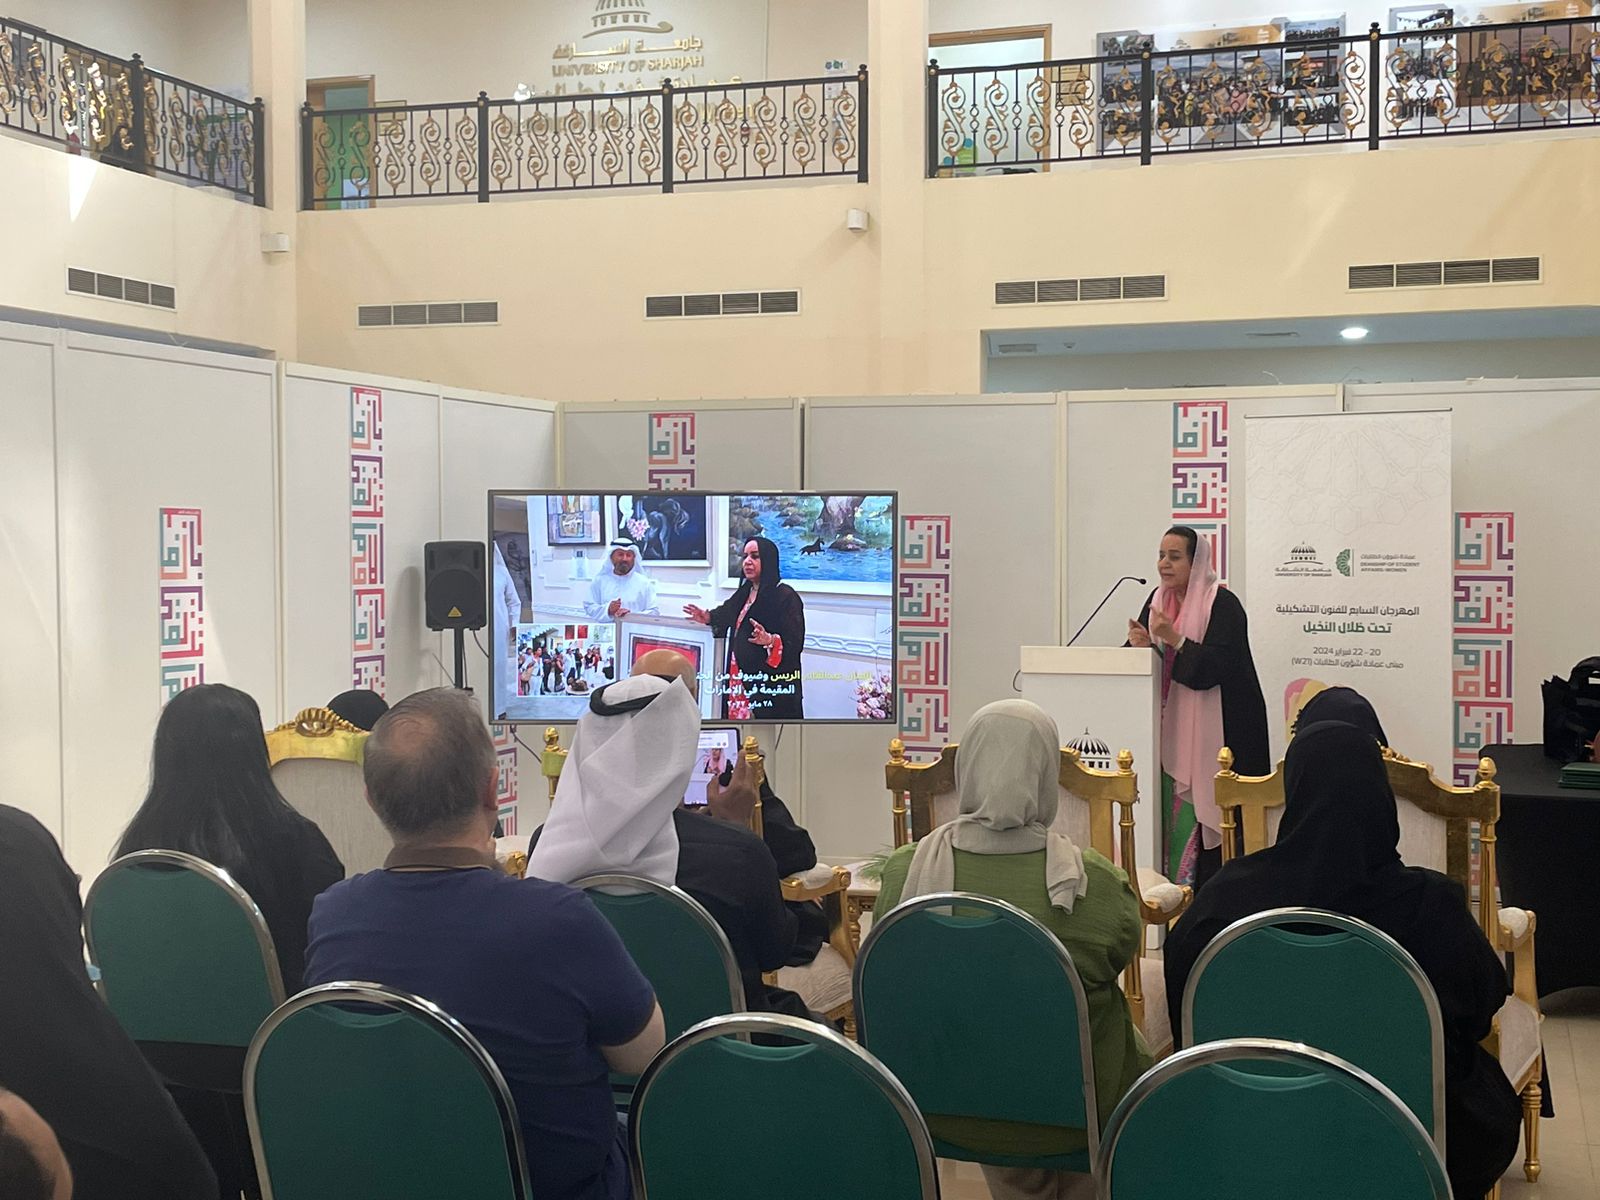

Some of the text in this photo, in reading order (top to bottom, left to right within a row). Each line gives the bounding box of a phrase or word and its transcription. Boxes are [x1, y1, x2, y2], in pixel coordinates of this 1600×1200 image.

[552, 55, 704, 77] UNIVERSITY OF SHARJAH
[1276, 604, 1420, 617] المهرجان السابع للفنون التشكيلية
[1303, 620, 1392, 634] تحت ظلال النخيل
[1313, 646, 1334, 655] 2024
[1352, 648, 1363, 656] 22
[1369, 648, 1381, 656] 20
[715, 671, 730, 682] من
[732, 669, 769, 682] وضيوف
[704, 683, 795, 698] المقيمة في الإمارات
[747, 700, 762, 709] مايو
